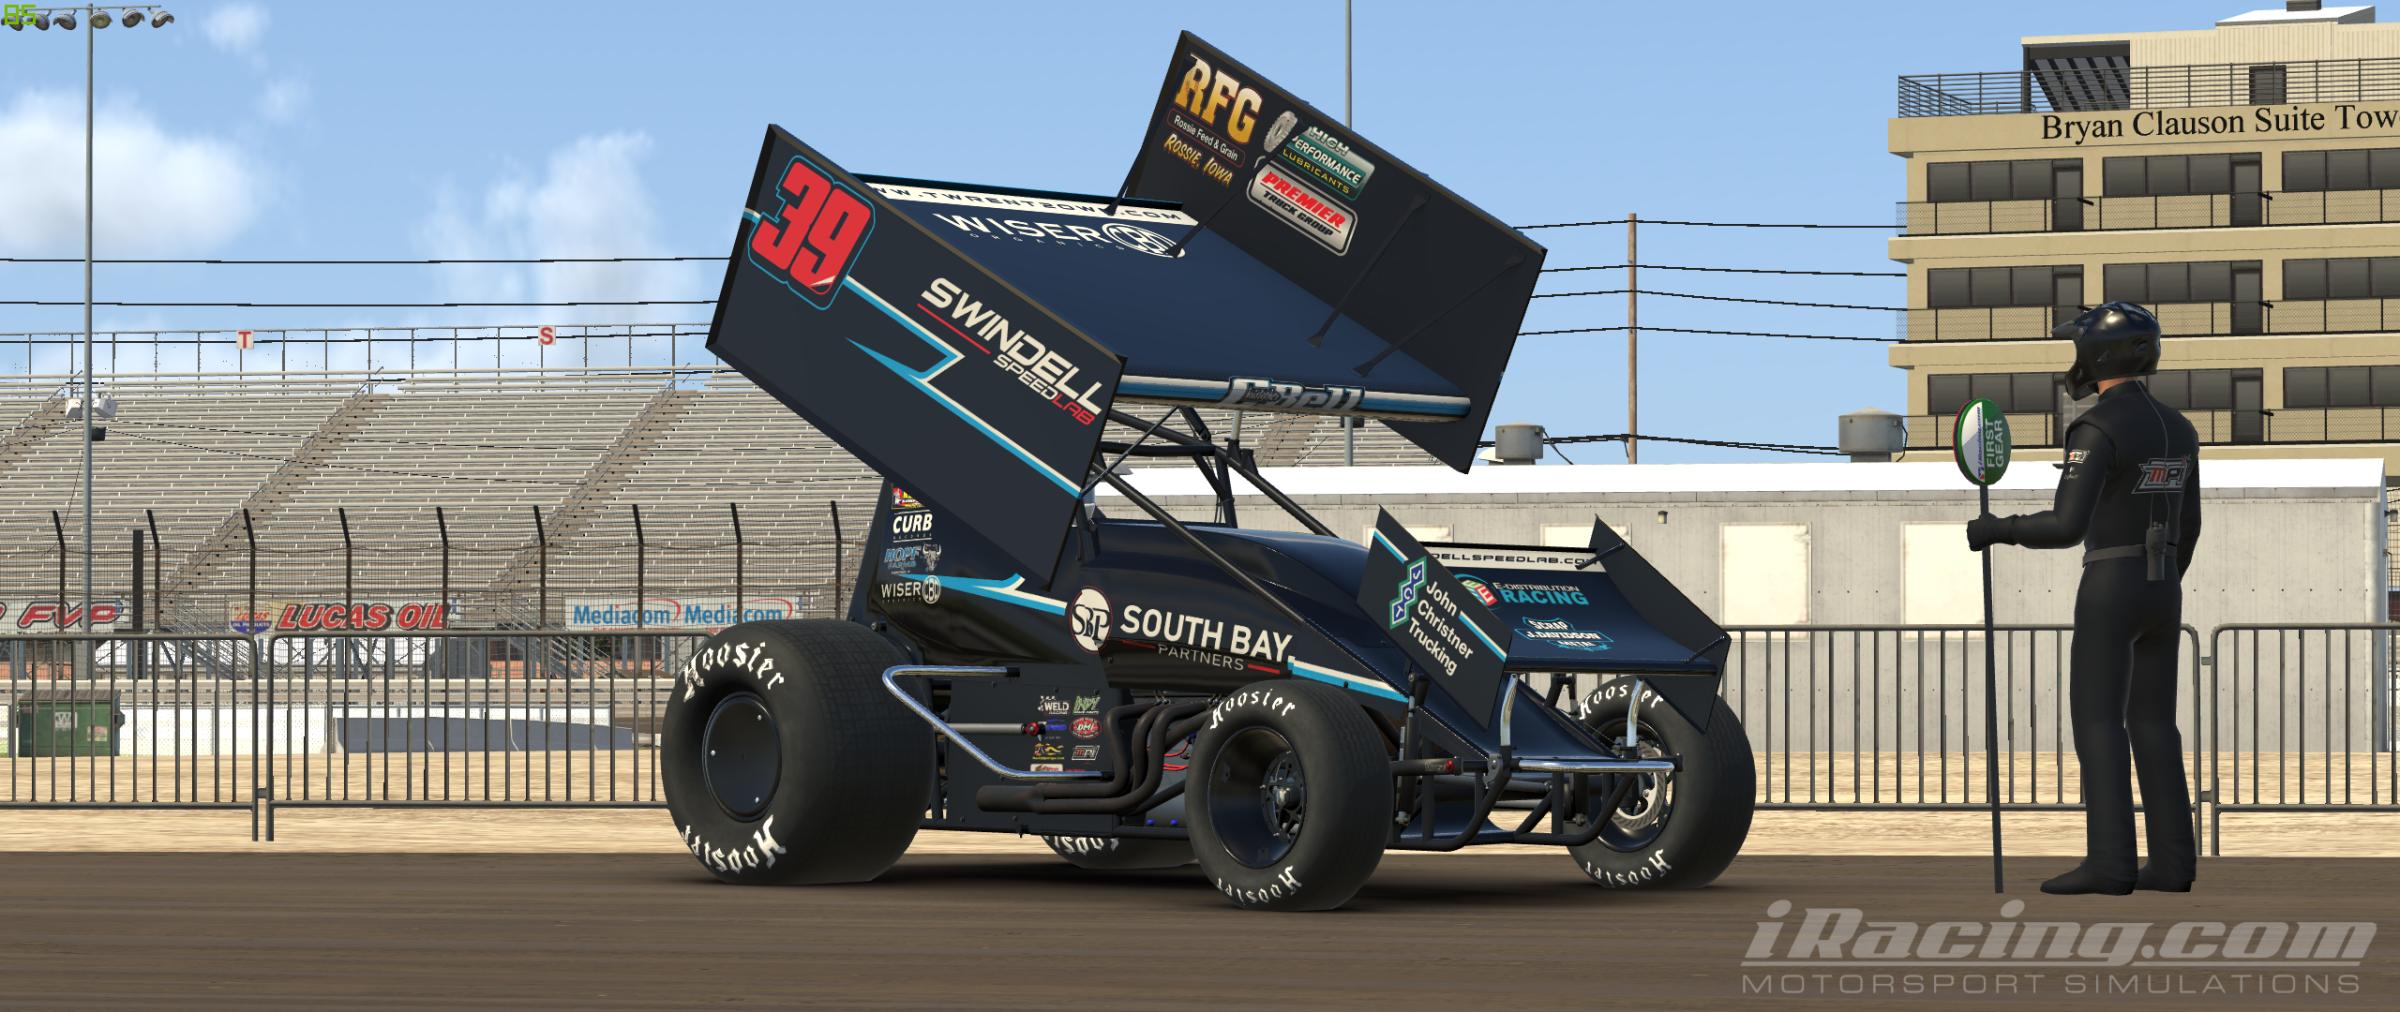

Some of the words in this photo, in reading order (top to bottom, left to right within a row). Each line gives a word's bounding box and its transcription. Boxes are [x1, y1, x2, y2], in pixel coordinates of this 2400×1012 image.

[1174, 53, 1262, 145] RFG
[1173, 115, 1197, 135] Rossie
[1196, 128, 1214, 146] Feed
[1213, 139, 1220, 150] &
[1220, 143, 1239, 161] Grain
[1308, 126, 1349, 157] HIGH
[2041, 114, 2124, 145] Bryan
[2133, 110, 2246, 136] Clauson
[2255, 105, 2325, 132] Suite
[2334, 104, 2400, 129] Tow
[1203, 157, 1234, 185] IOWA
[1282, 148, 1350, 194] LUBRICANTS
[1262, 171, 1345, 229] PREMIER
[1263, 190, 1298, 216] TRUCK
[1297, 211, 1334, 236] GROUP
[750, 161, 872, 297] 39
[933, 213, 1113, 244] WISER
[239, 332, 250, 348] T
[541, 327, 554, 344] S
[921, 277, 1102, 416] SWINDELL
[993, 354, 1096, 426] SPEEDLAB
[1985, 418, 1995, 467] FIRST
[1994, 420, 2005, 467] GEAR
[893, 514, 933, 534] CURB
[881, 582, 921, 598] WISER
[1426, 581, 1458, 617] John
[1492, 582, 1580, 592] E-DISTRIBUTION
[1500, 589, 1590, 606] RACING
[276, 603, 393, 631] LUCAS
[573, 604, 671, 625] Mediacom
[684, 604, 782, 625] Mediacom
[1120, 604, 1223, 650] SOUTH
[1417, 599, 1474, 659] Christner
[1158, 643, 1244, 671] PARTNERS
[1408, 616, 1458, 677] Trucking
[683, 641, 785, 702] Hoosier
[1044, 702, 1069, 711] WELD
[1209, 688, 1296, 730] Hoosier
[1579, 684, 1664, 720] Hooser
[681, 814, 787, 875] Hoosier
[1216, 865, 1302, 907] Hoosier
[1584, 848, 1674, 886] Hoosier
